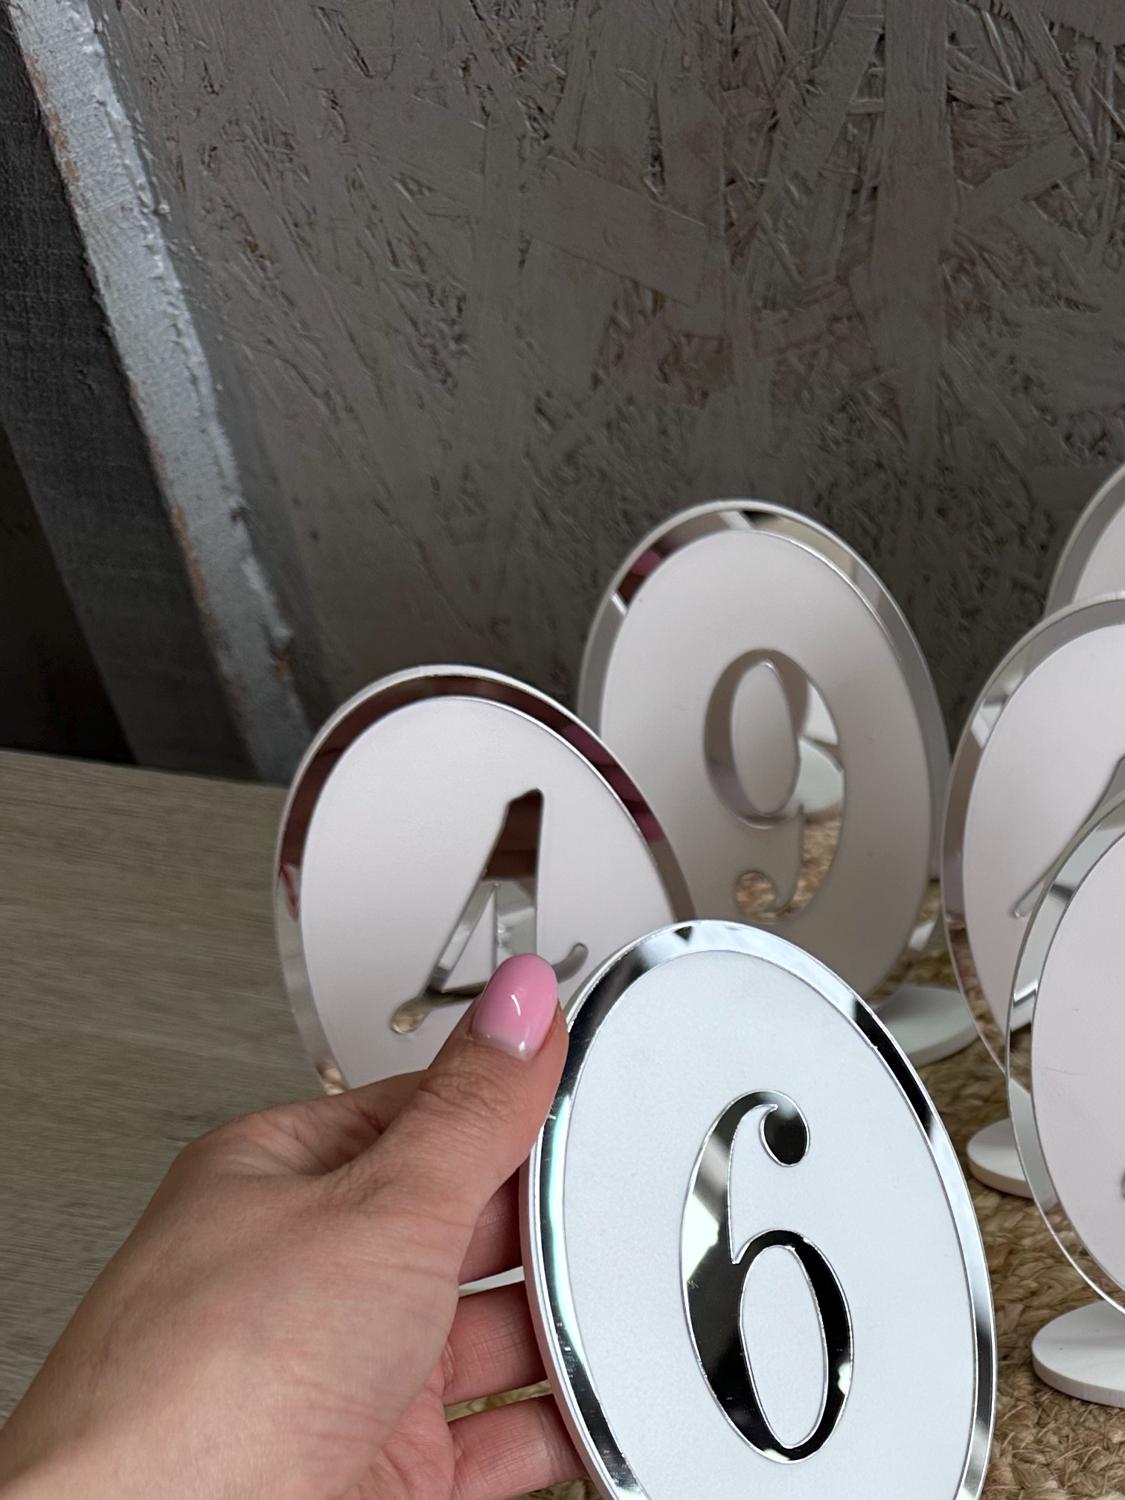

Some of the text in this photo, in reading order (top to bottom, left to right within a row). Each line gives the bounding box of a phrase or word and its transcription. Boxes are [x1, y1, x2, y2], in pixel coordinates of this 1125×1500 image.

[391, 788, 589, 1034] 4
[704, 649, 846, 922] 9
[681, 1089, 854, 1464] 6
